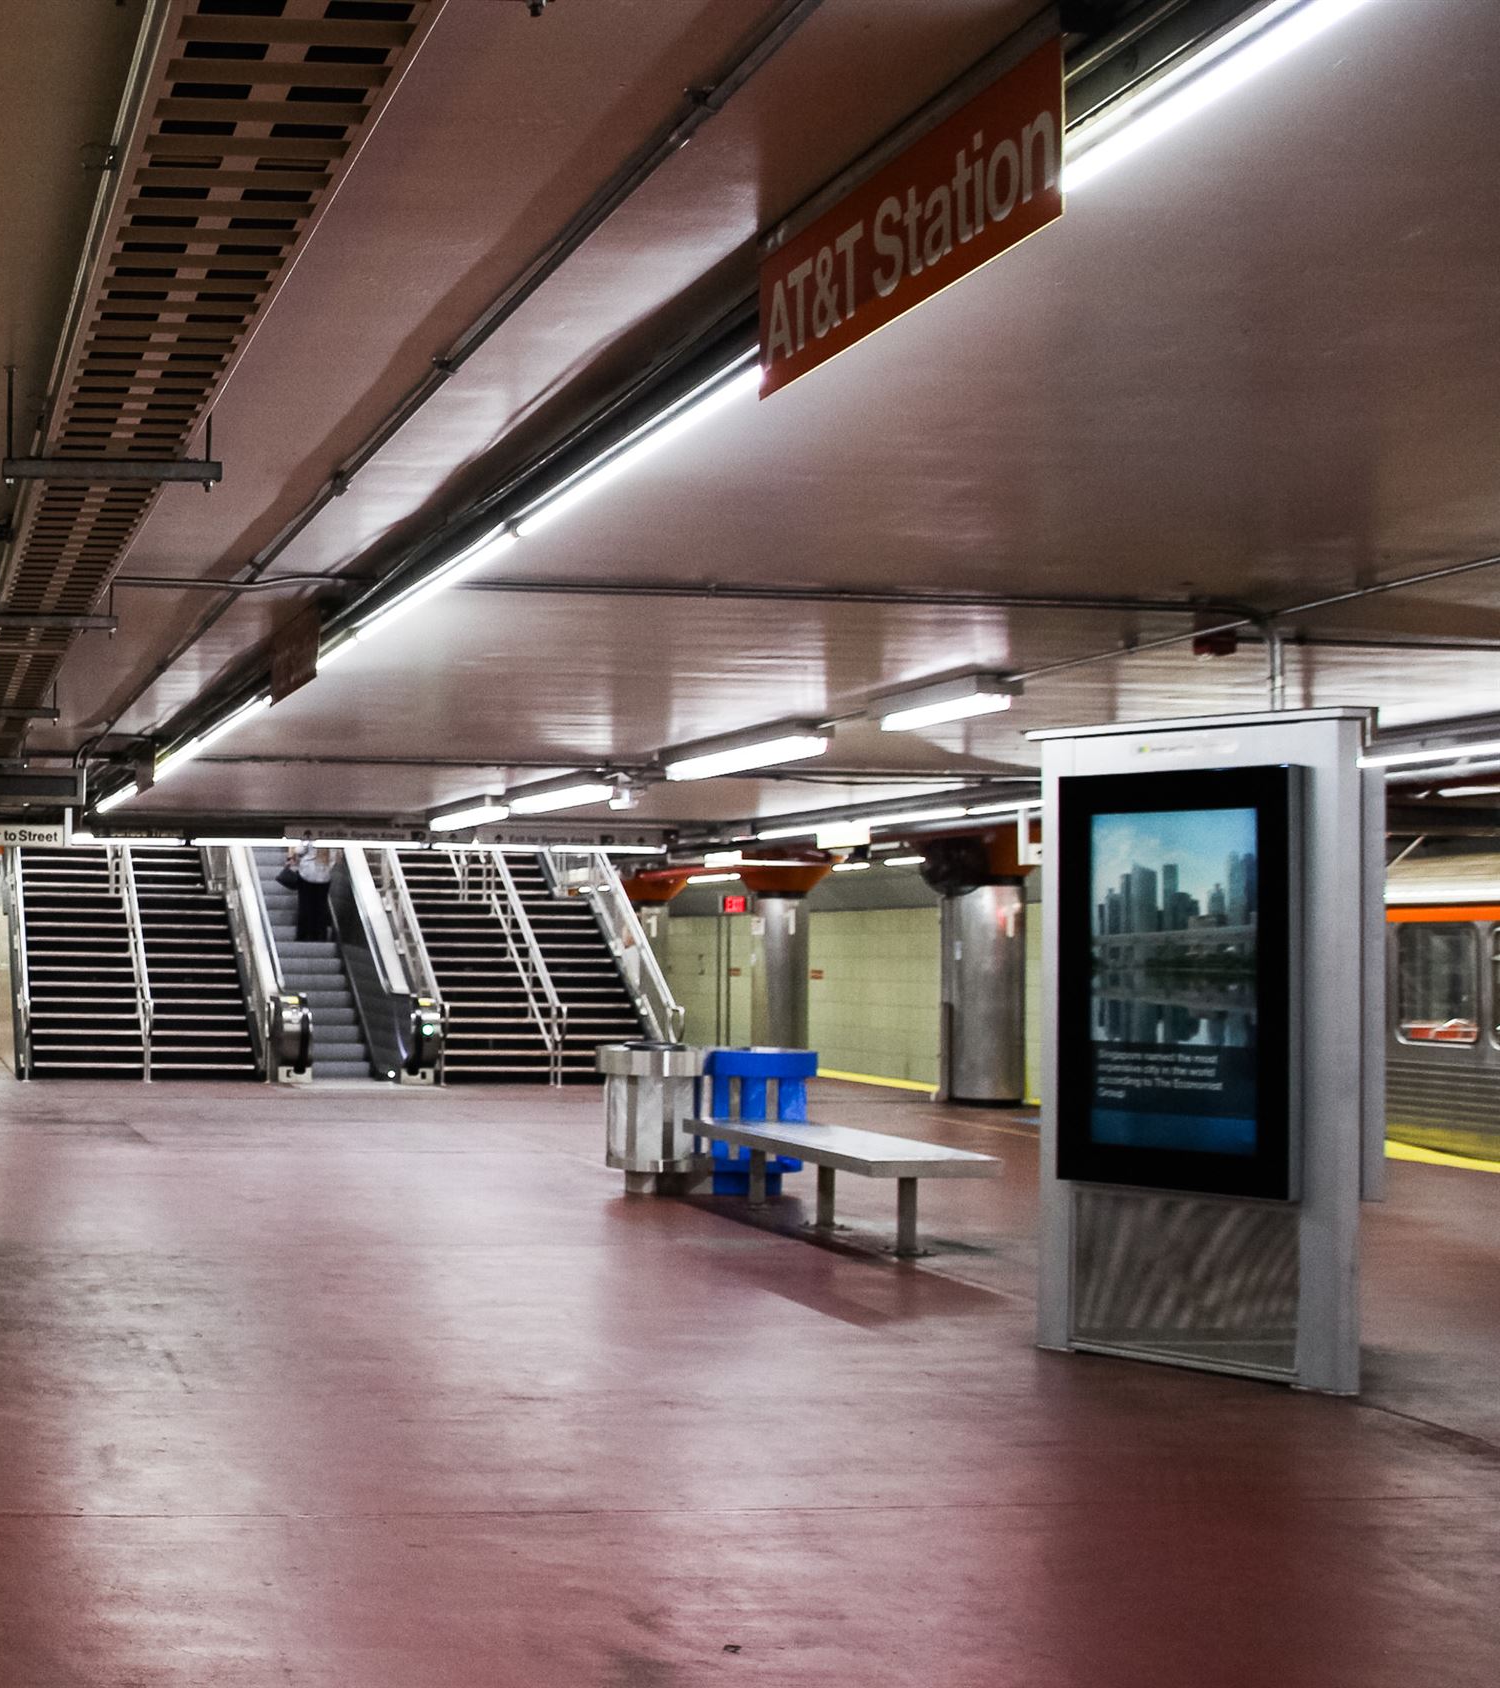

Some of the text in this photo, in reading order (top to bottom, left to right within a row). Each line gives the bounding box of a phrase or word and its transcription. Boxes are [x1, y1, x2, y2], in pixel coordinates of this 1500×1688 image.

[765, 110, 1054, 370] AT&T Station
[4, 830, 17, 842] to
[19, 830, 58, 842] Street
